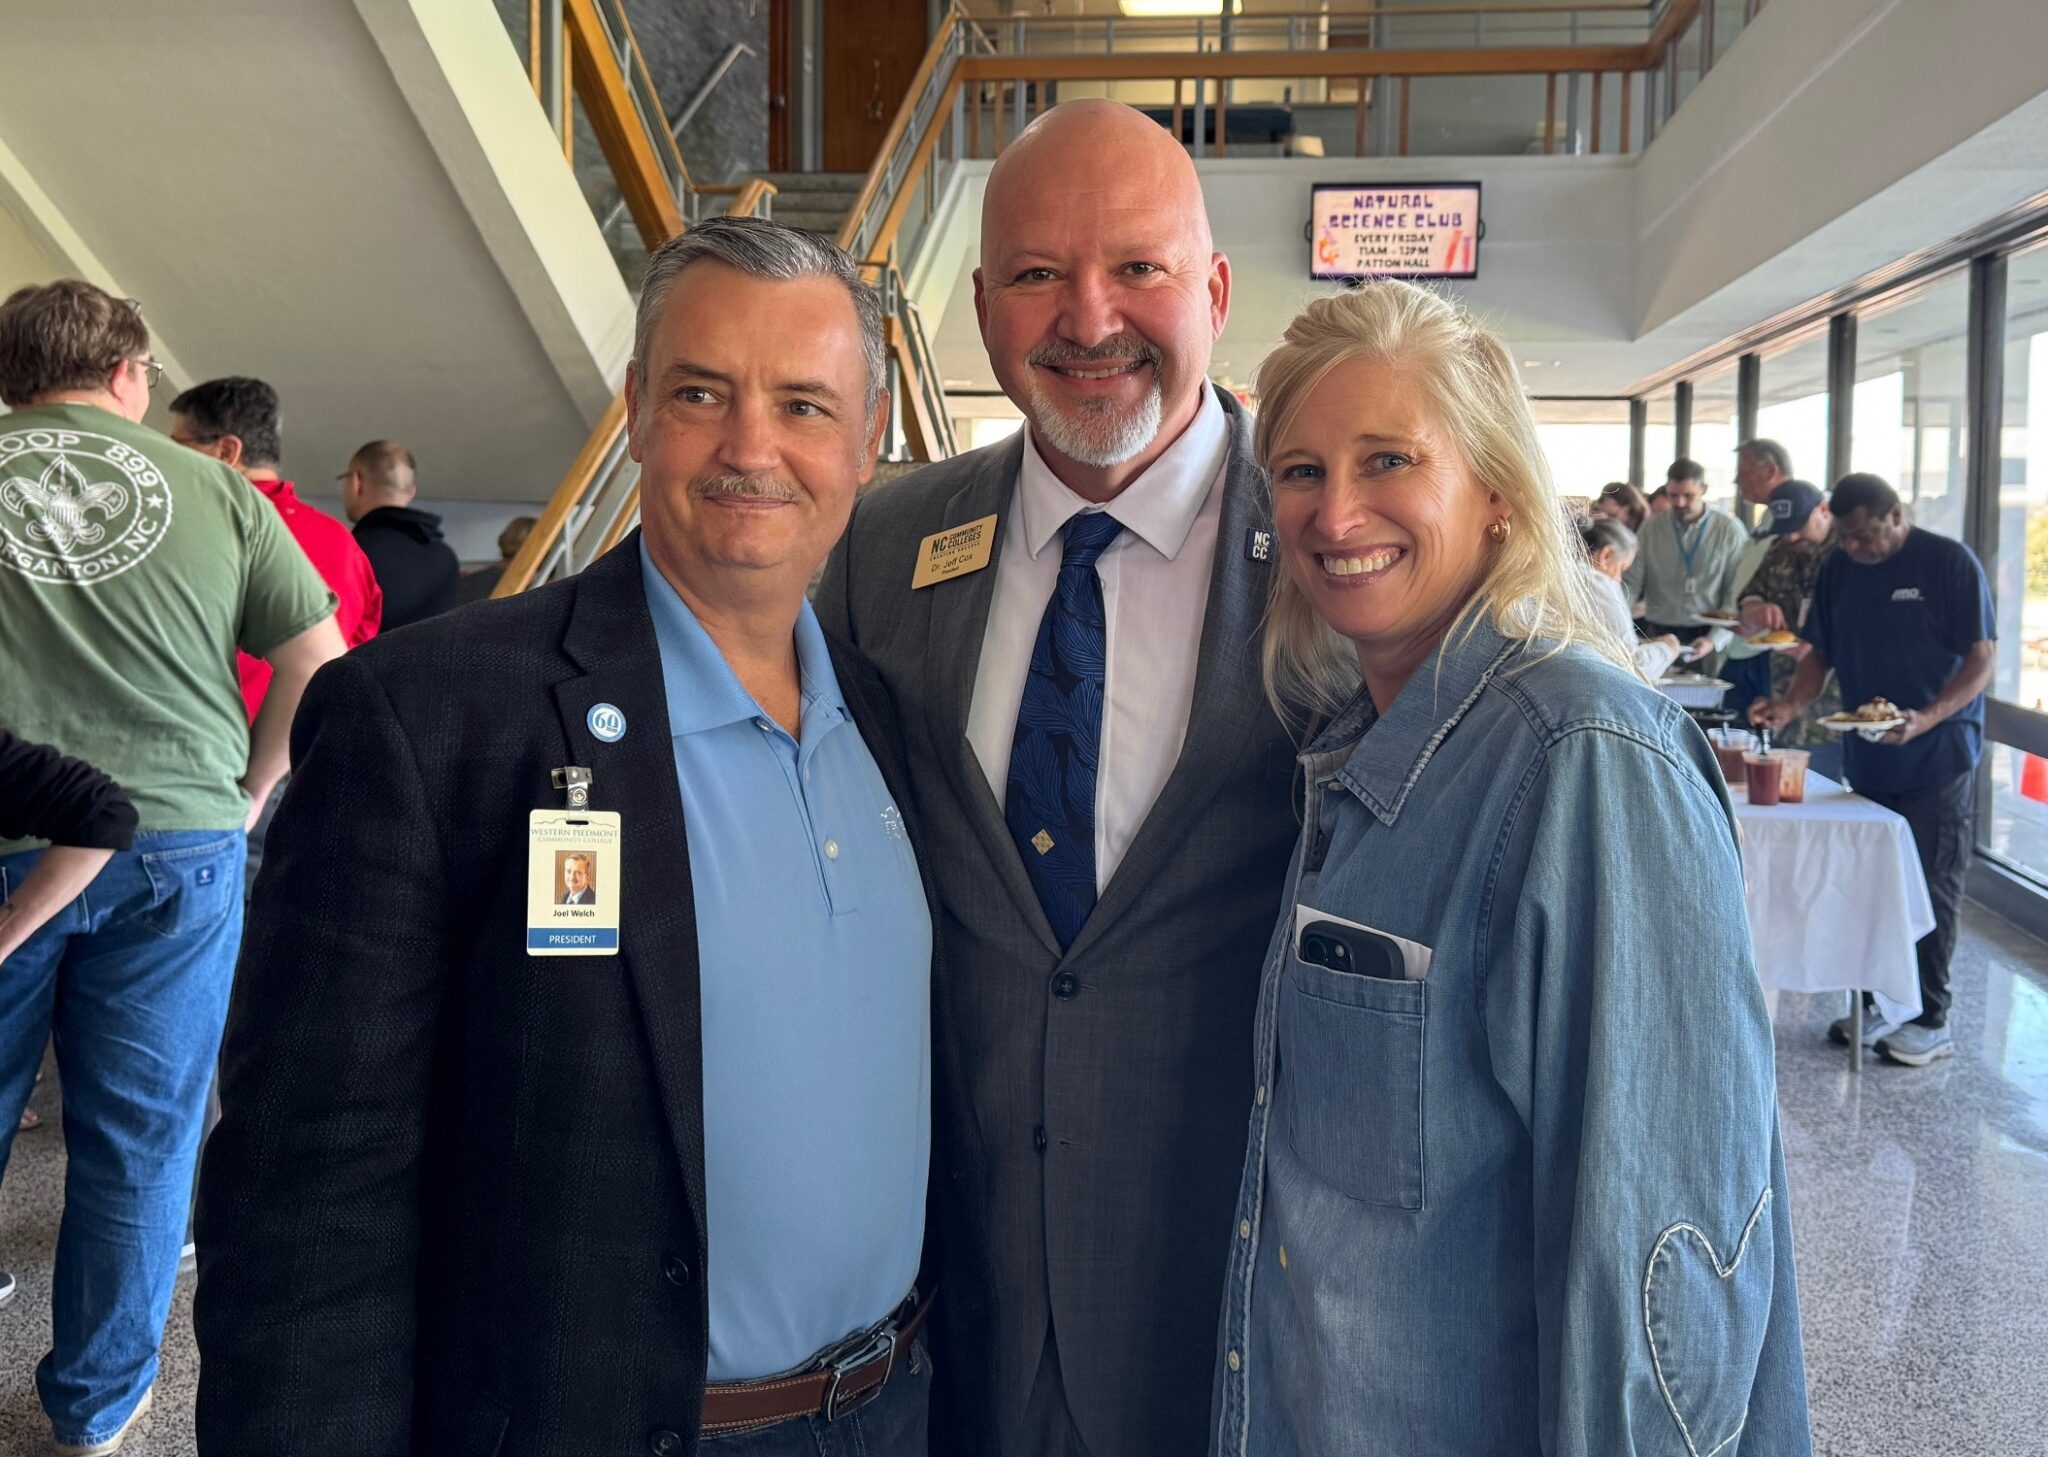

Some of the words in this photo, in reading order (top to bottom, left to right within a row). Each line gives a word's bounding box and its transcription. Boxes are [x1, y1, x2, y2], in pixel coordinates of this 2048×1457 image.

[1353, 194, 1433, 208] NATURAL
[1329, 214, 1407, 228] SCIENCE
[1415, 213, 1462, 227] CLUB
[1354, 234, 1389, 243] EVERY
[1391, 234, 1434, 243] FRIDAY
[1400, 246, 1429, 255] 12PM
[1357, 259, 1401, 267] PATTON
[1403, 259, 1430, 267] HALL
[0, 432, 80, 457] OOP
[105, 445, 159, 487] 899
[930, 536, 948, 555] NC
[949, 524, 983, 540] COMMUNITY
[947, 531, 982, 549] COLLEGES
[1254, 531, 1270, 546] NC
[0, 536, 130, 578] RGANTON,
[124, 517, 158, 551] NC
[1252, 545, 1268, 560] CC
[943, 556, 958, 569] Jeff
[958, 553, 974, 563] Cox
[594, 711, 619, 729] 60
[573, 829, 618, 838] PIEDMONT
[553, 909, 569, 917] Joel
[571, 909, 595, 917] Welch
[549, 934, 597, 944] PRESIDENT
